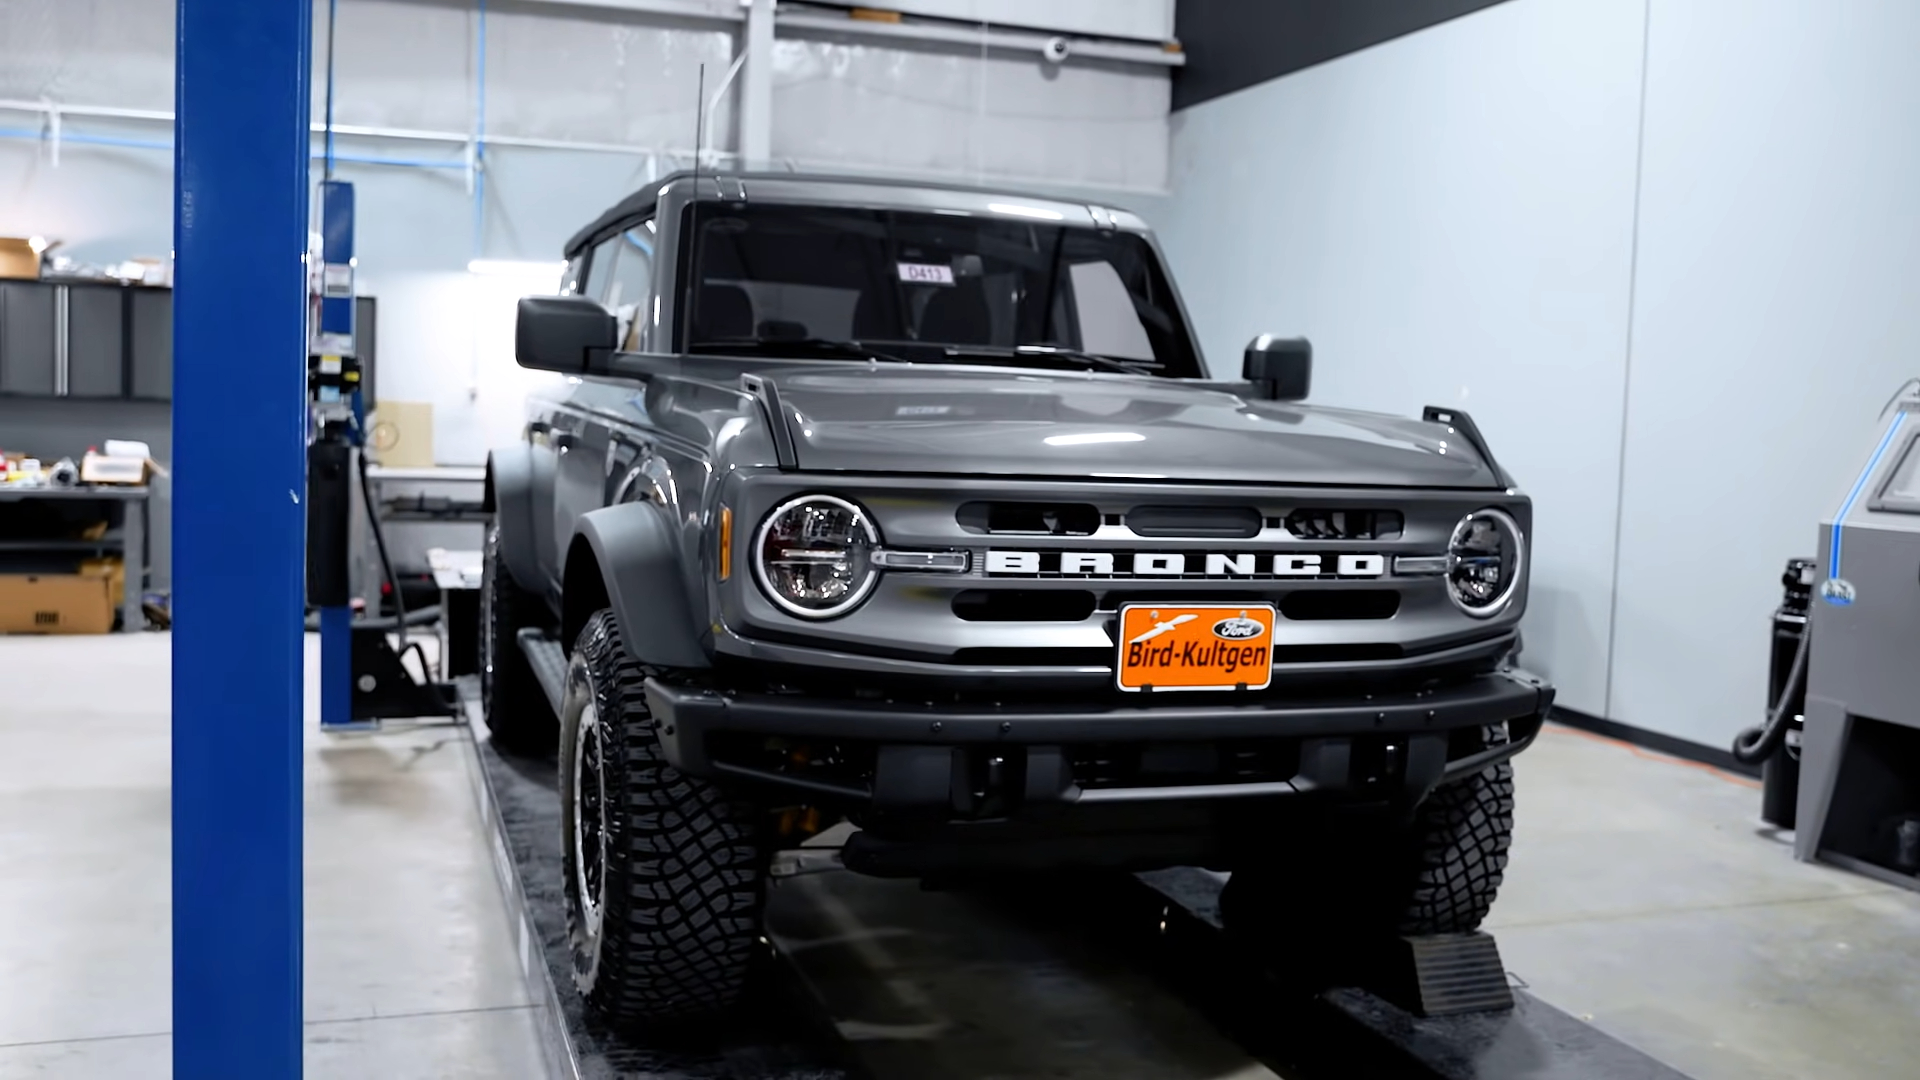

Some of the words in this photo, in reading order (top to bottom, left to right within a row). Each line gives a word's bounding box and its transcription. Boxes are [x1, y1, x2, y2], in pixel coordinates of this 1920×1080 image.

[985, 551, 1384, 575] BRONCO
[1220, 619, 1254, 637] Ford
[1127, 640, 1267, 673] Bird-Kultgen
